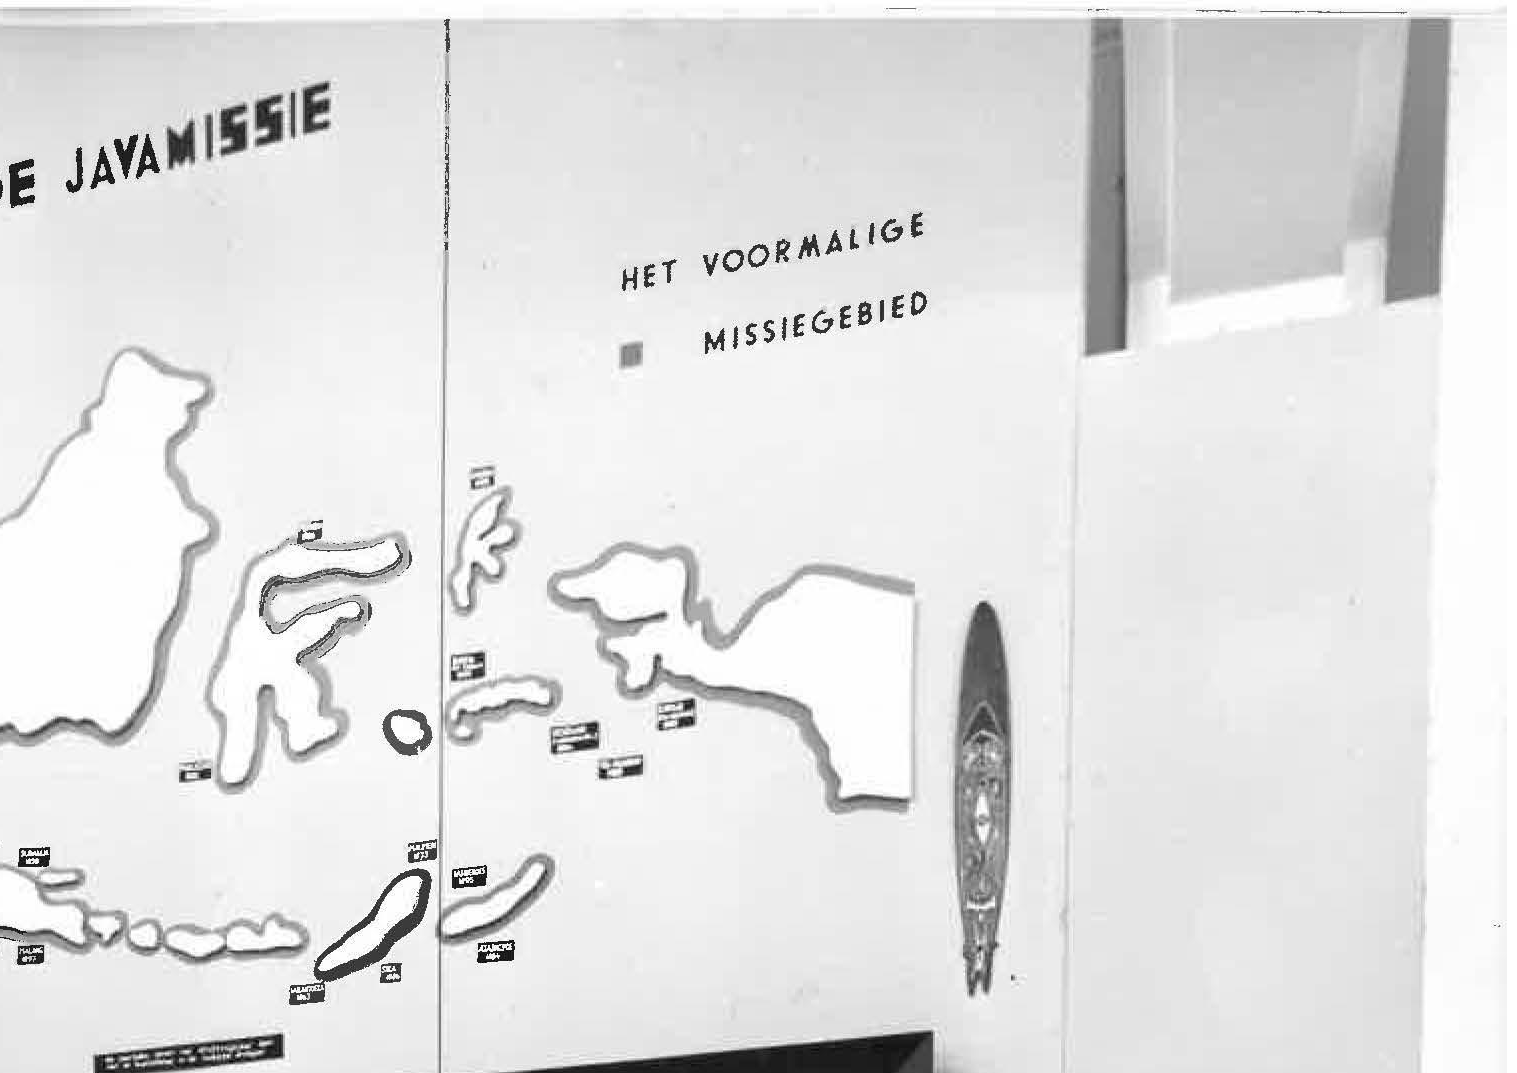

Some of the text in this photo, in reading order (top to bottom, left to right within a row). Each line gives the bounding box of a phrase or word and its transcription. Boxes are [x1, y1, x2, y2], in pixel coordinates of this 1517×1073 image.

[621, 212, 924, 292] HET VOORMALIGE
[704, 290, 928, 355] MISSIEGEBIED
